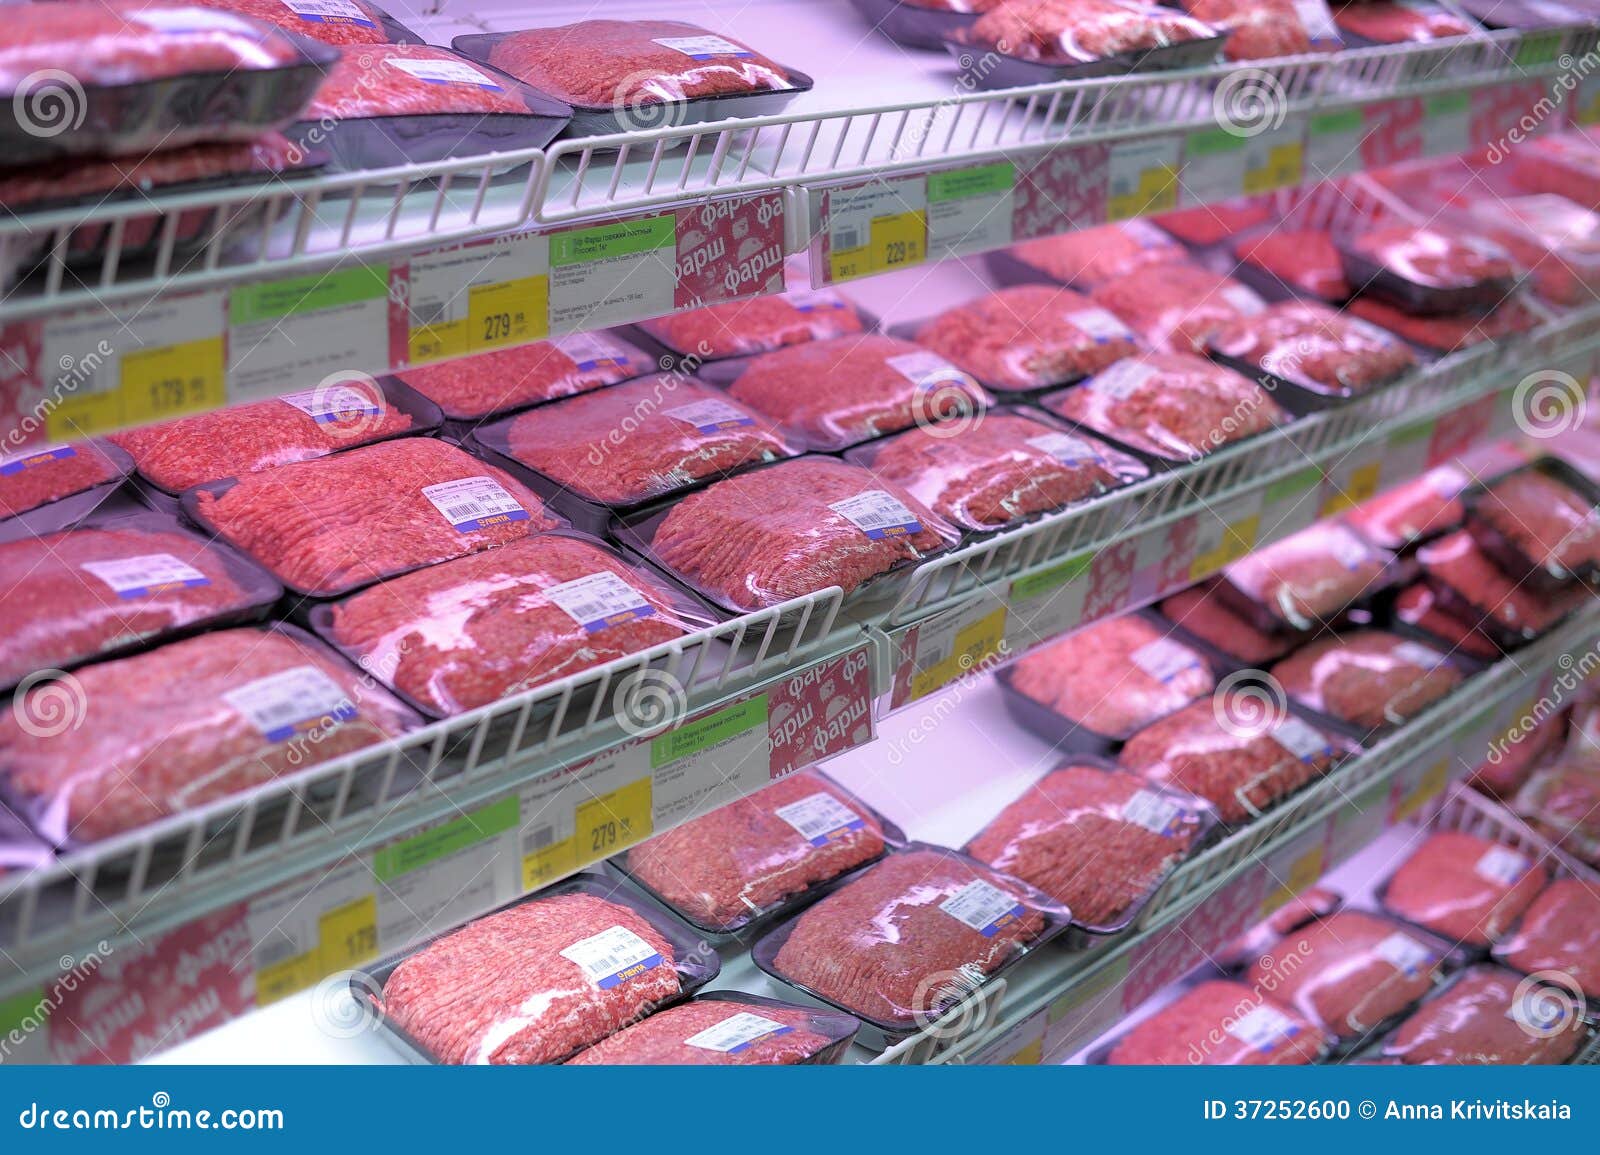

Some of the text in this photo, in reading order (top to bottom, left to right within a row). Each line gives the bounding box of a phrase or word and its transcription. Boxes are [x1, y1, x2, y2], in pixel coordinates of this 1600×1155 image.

[725, 244, 783, 295] фарш
[484, 312, 511, 341] 279
[813, 695, 868, 754] фарш
[592, 821, 616, 851] 279
